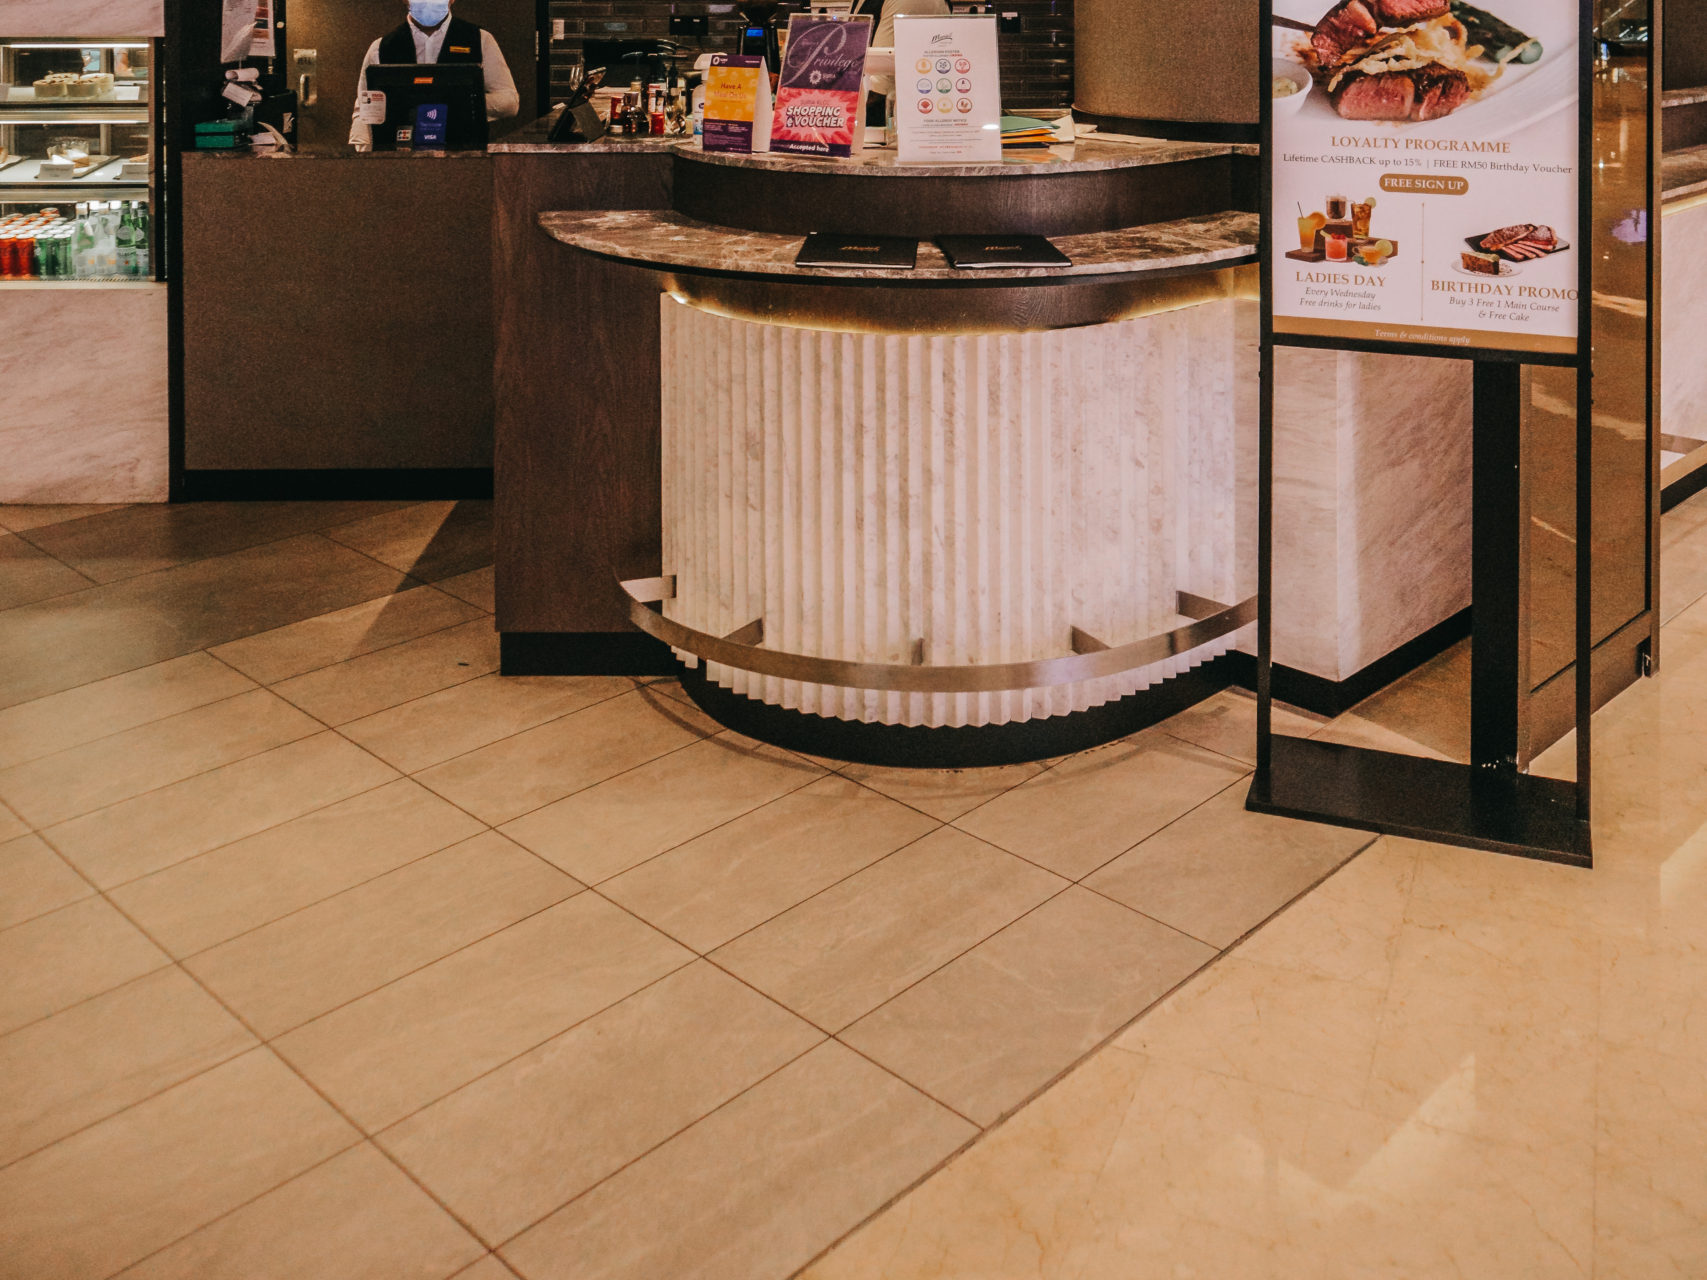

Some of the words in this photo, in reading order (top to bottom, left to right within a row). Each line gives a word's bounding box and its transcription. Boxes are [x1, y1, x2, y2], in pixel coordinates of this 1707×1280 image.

[786, 106, 841, 117] SHOPPING
[789, 143, 815, 152] Accepted
[1330, 136, 1400, 149] LOYALTY
[1405, 138, 1511, 153] PROGRAMME
[1283, 153, 1318, 163] Lifetime
[1320, 155, 1377, 166] CASHBACK
[1378, 159, 1390, 168] up
[1393, 158, 1402, 166] to
[1404, 158, 1422, 167] 15%
[1433, 159, 1458, 169] FREE
[1461, 160, 1488, 170] RM50
[1490, 161, 1530, 174] Birthday
[1533, 163, 1573, 174] Voucher
[1384, 177, 1413, 189] FREE
[1414, 179, 1445, 190] SIGN
[1447, 180, 1465, 191] UP
[1295, 271, 1350, 285] LADIES
[1354, 274, 1387, 287] DAY
[1305, 286, 1329, 297] Every
[1330, 288, 1377, 300] Wednesday
[1431, 279, 1516, 297] BIRTHDAY
[1518, 285, 1579, 301] PROMO
[1299, 297, 1316, 307] Free
[1318, 298, 1343, 309] drinks
[1344, 300, 1356, 312] for
[1358, 301, 1382, 311] ladies
[1449, 296, 1467, 307] Buy
[1476, 298, 1495, 308] Free
[1504, 299, 1528, 311] Main
[1530, 301, 1560, 312] Course
[1478, 310, 1487, 319] &
[1489, 310, 1507, 320] Free
[1509, 311, 1530, 322] Cake
[1375, 328, 1398, 338] Terms
[1399, 331, 1408, 339] &
[1408, 332, 1448, 342] conditions
[1449, 335, 1472, 345] apply
